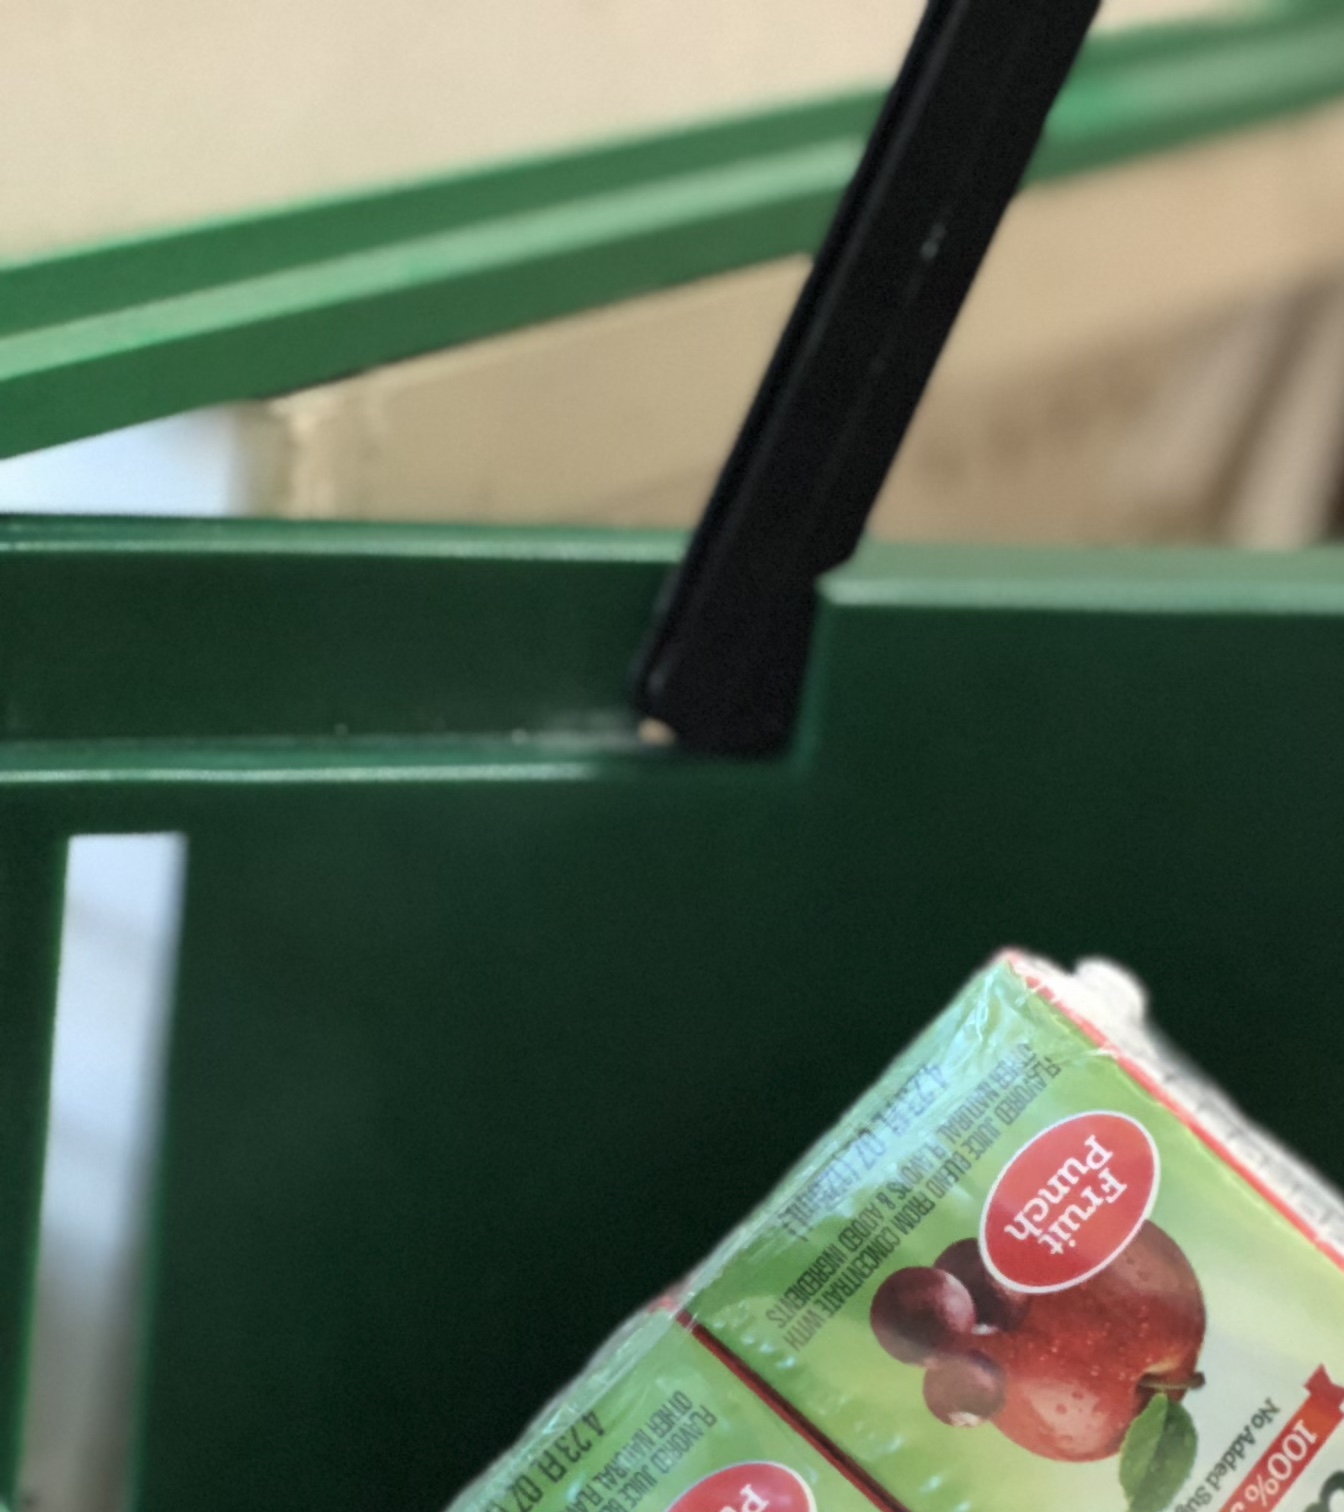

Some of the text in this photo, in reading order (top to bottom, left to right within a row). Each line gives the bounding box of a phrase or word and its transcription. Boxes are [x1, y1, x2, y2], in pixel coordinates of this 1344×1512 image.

[780, 1055, 1061, 1352] FLAVORED JUICE BLEND FROM CONCENTRATE WITH
[1004, 1134, 1114, 1242] Punch
[1046, 1168, 1128, 1256] Fruit
[834, 1200, 888, 1253] ADDED
[762, 1241, 850, 1330] INGREDIENTS
[643, 1389, 695, 1438] OTHER
[646, 1404, 719, 1474] FLAVORED
[1247, 1395, 1283, 1434] No
[591, 1428, 658, 1492] NATURAL
[614, 1463, 662, 1508] JUICE
[1203, 1424, 1261, 1492] Added
[1244, 1418, 1320, 1509] 100%
